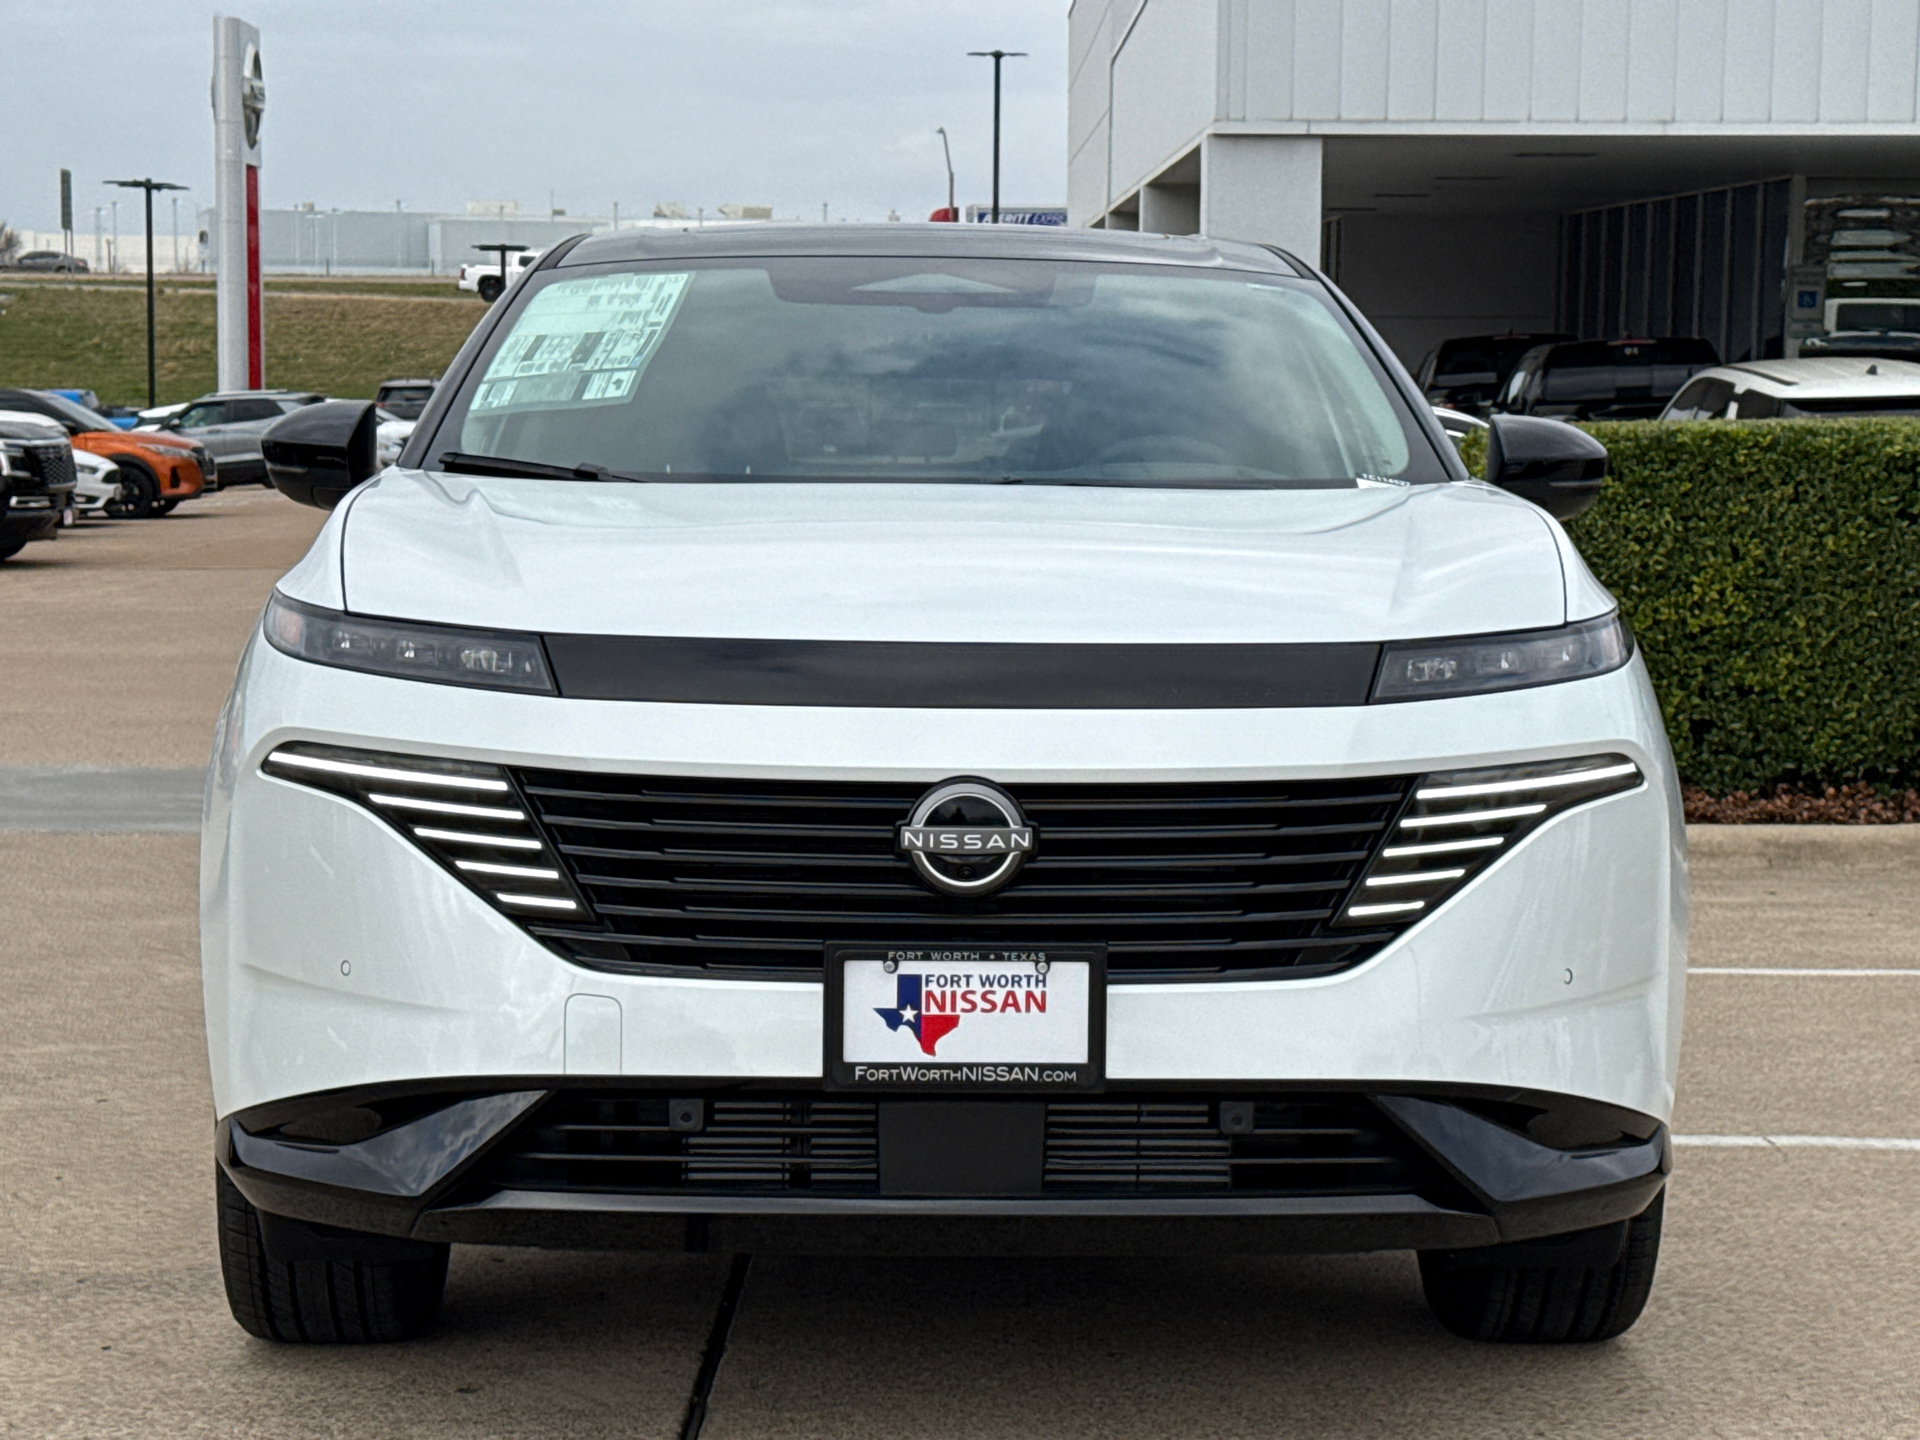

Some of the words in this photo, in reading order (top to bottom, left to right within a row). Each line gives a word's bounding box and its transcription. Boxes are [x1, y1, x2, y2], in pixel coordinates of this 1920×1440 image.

[983, 213, 1032, 225] AERITT
[904, 831, 1029, 849] NISSAN
[888, 951, 924, 961] FORT
[930, 952, 980, 961] WORTH
[1002, 952, 1046, 961] TEXAS
[924, 974, 974, 988] FORT
[979, 974, 1047, 989] WORTH
[924, 990, 1047, 1013] NISSAN
